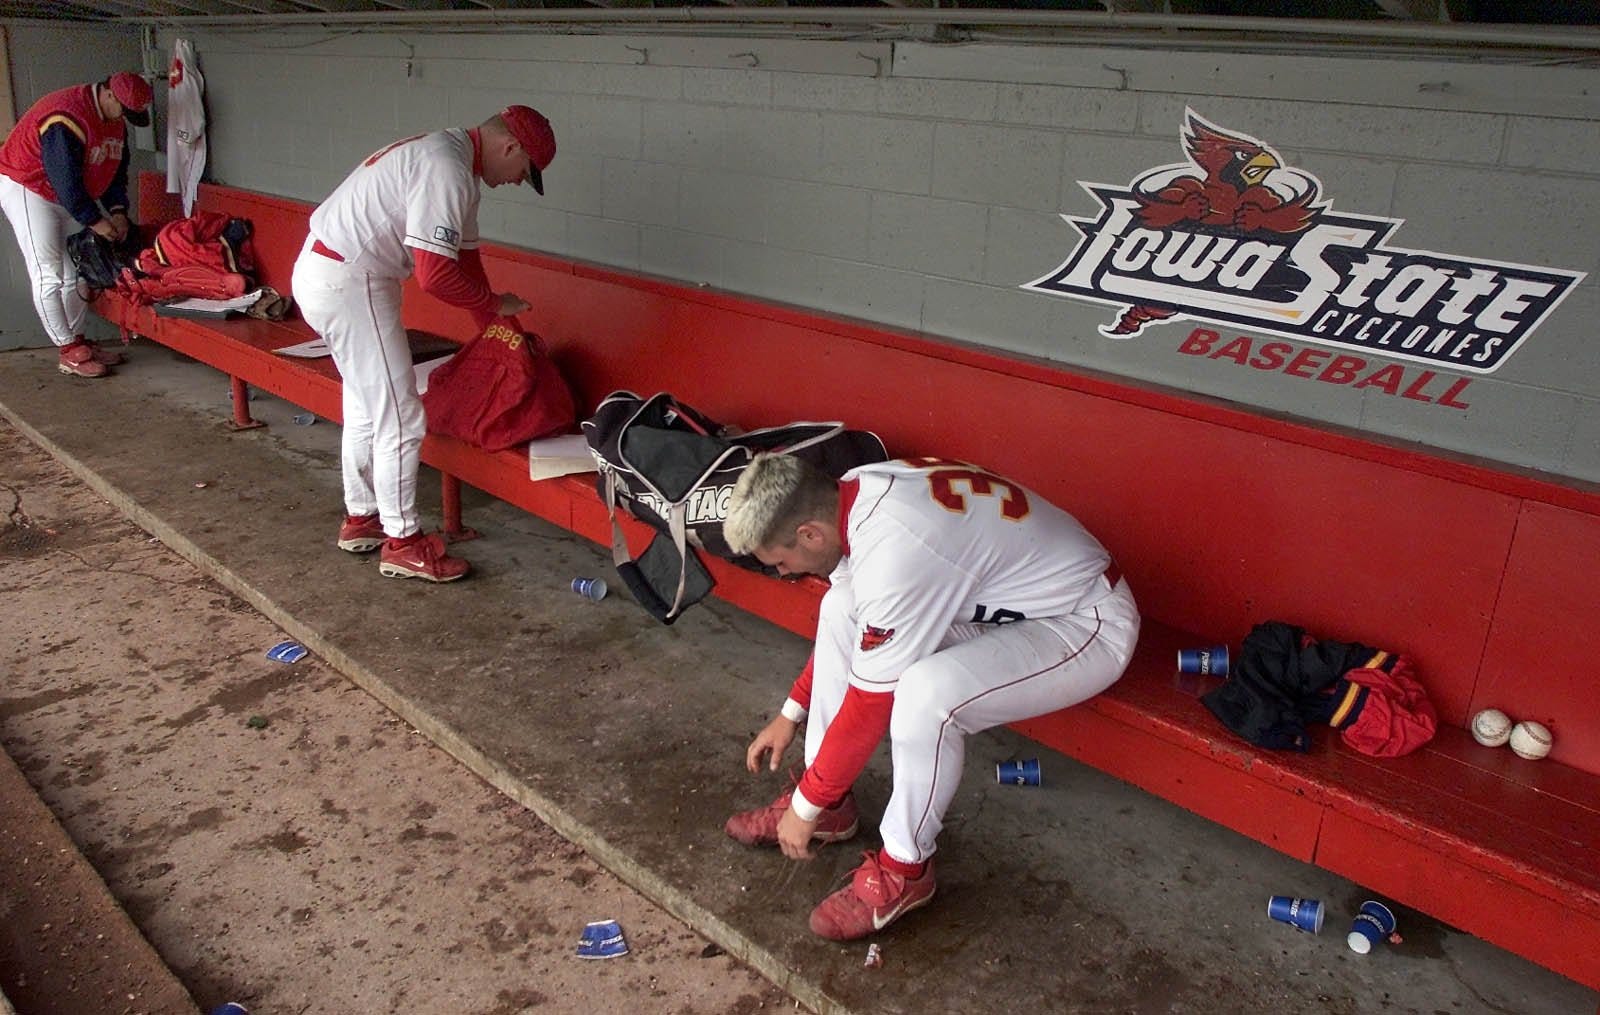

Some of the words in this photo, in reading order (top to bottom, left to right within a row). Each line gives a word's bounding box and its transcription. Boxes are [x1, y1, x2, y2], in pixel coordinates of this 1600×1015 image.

[1057, 197, 1287, 291] Iowa
[482, 324, 523, 350] Base
[1176, 327, 1473, 410] BASEBALL
[1311, 309, 1503, 362] CYCLONES
